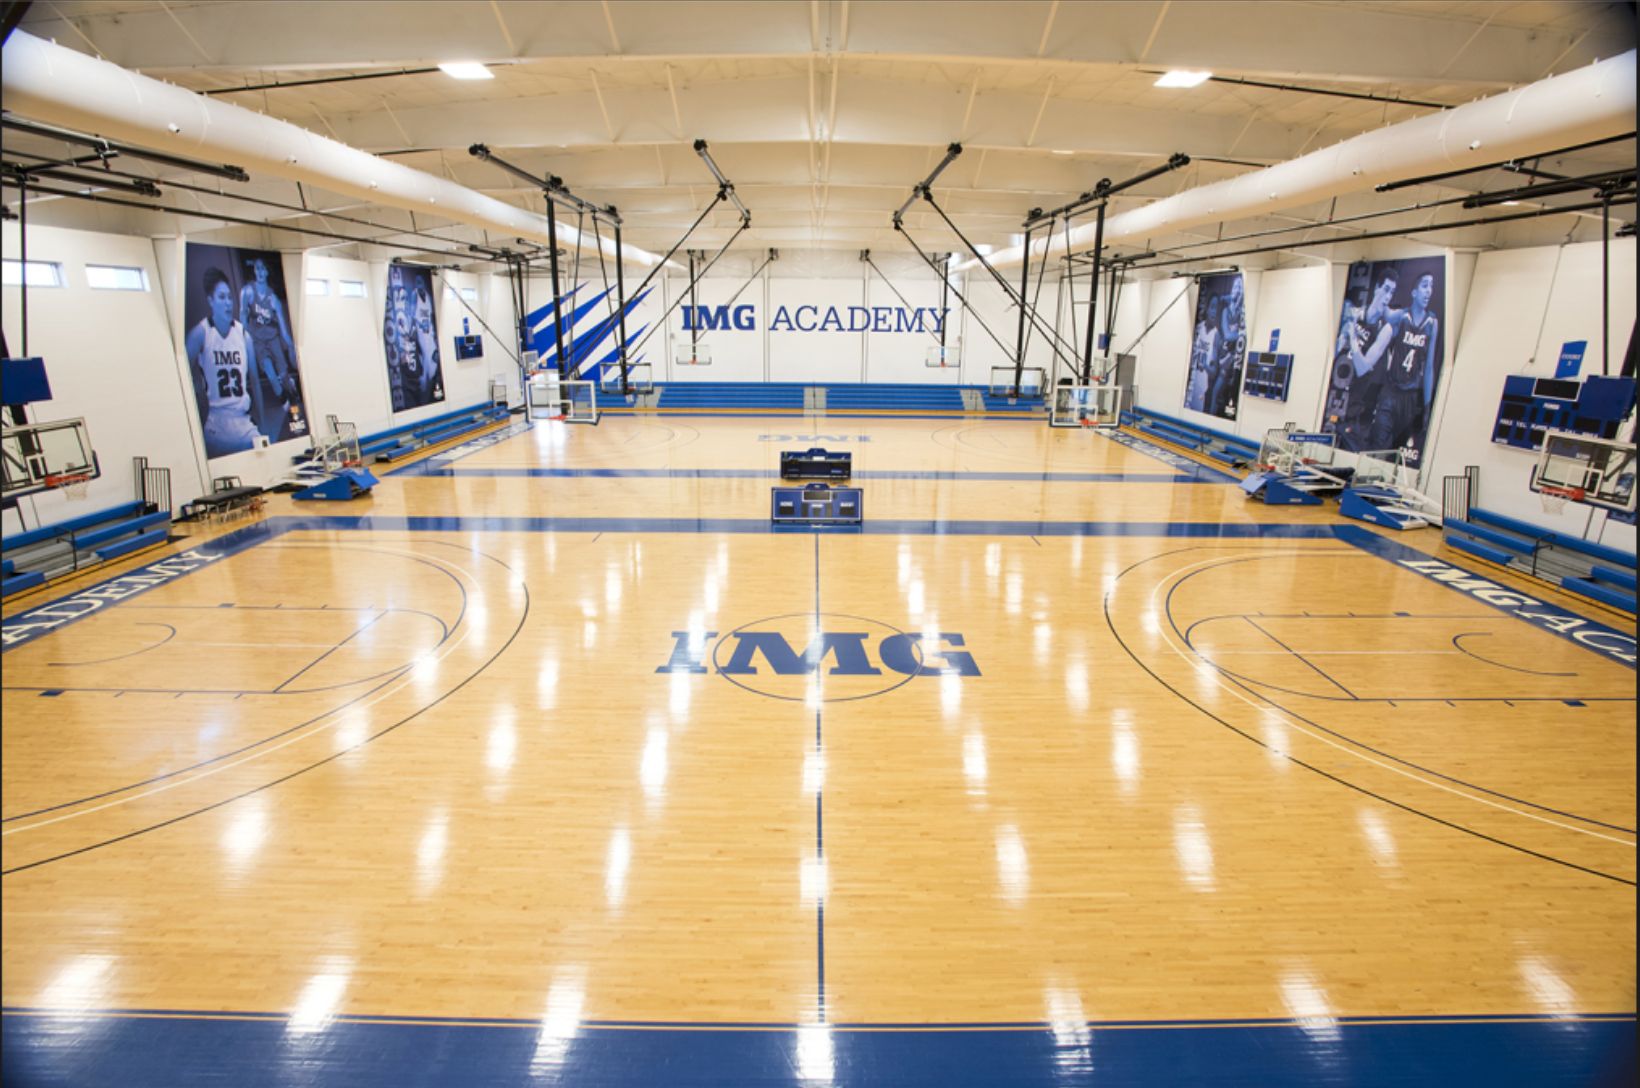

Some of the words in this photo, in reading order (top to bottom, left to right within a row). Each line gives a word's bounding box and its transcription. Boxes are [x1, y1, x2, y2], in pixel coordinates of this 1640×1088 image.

[681, 305, 755, 331] IMG
[769, 306, 951, 333] ACADEMY
[1403, 331, 1426, 347] IMG
[213, 350, 242, 366] IMG
[1402, 349, 1415, 372] 4
[217, 368, 244, 398] 23
[1398, 559, 1543, 606] IMG
[1513, 609, 1637, 662] AC
[654, 631, 983, 677] IMG
